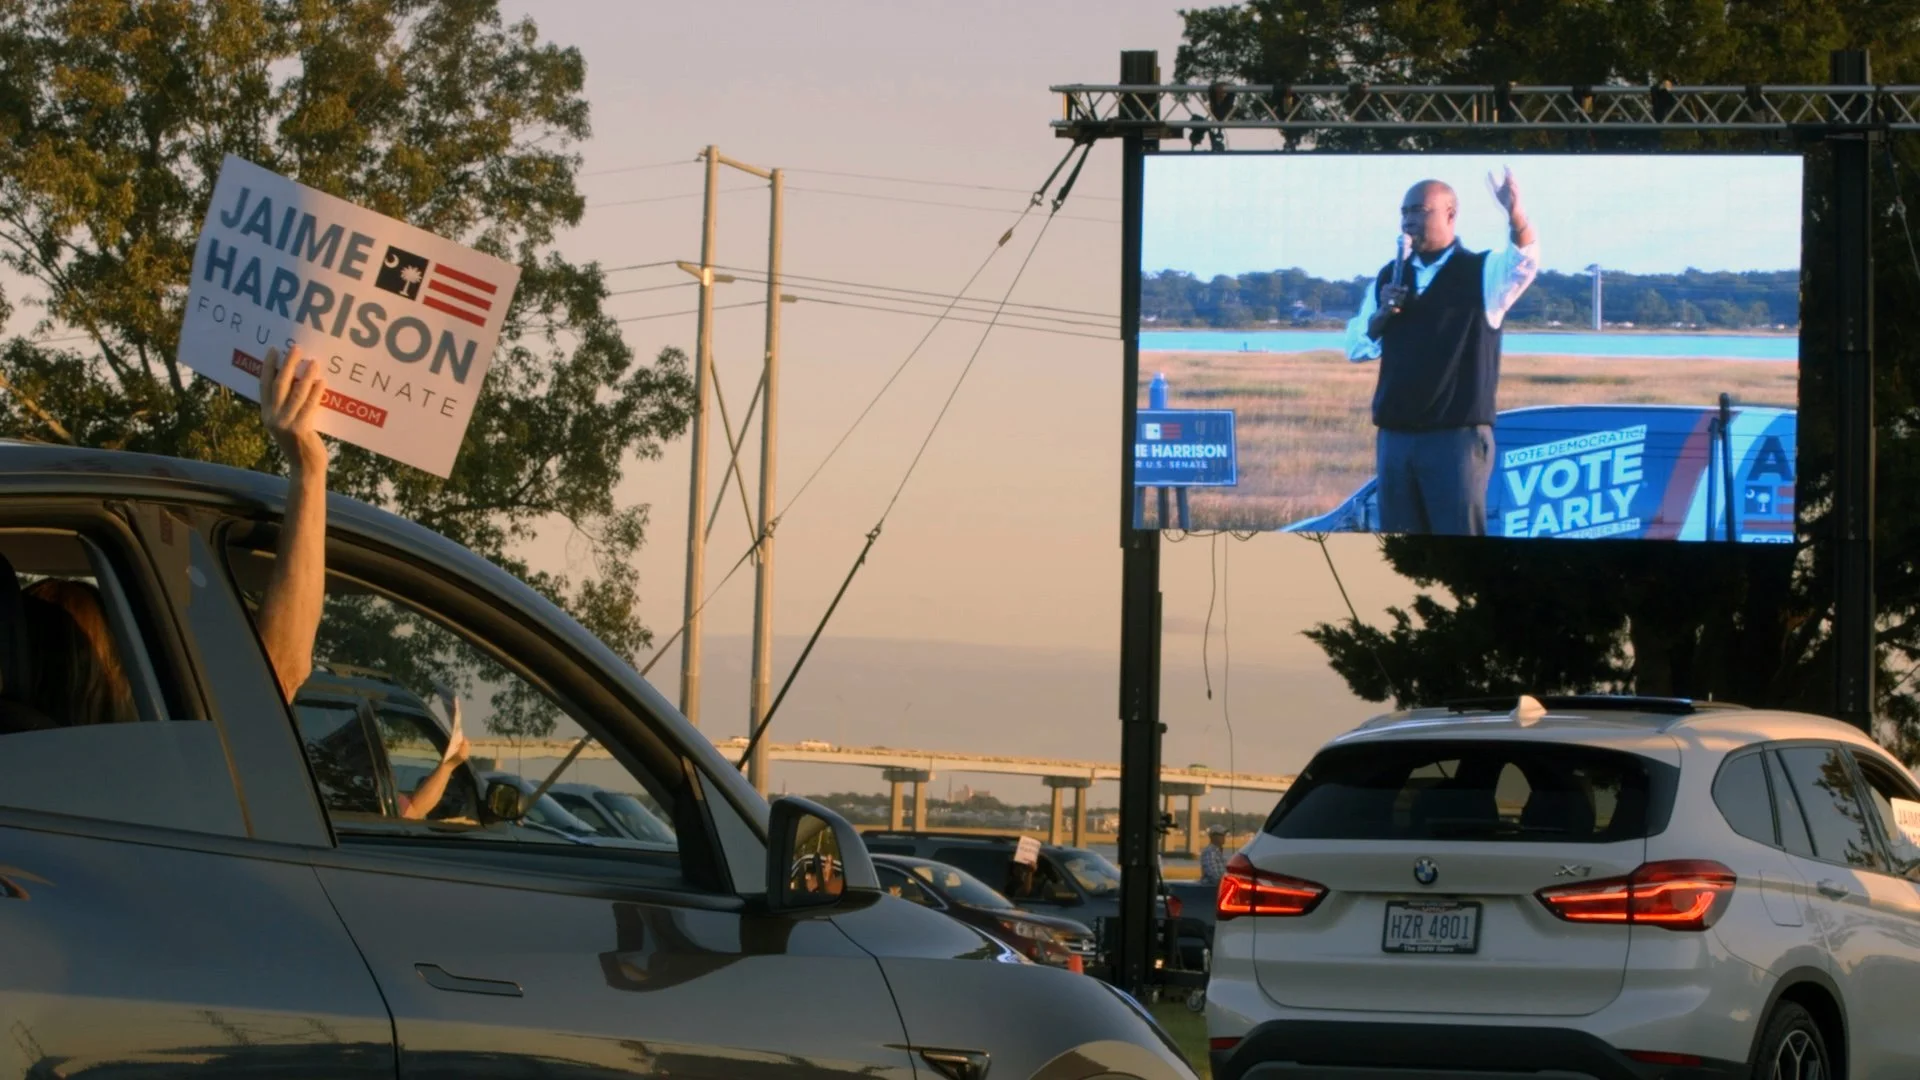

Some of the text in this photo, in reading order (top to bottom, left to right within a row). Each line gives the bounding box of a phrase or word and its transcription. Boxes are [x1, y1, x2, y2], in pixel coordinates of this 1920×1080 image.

[221, 187, 375, 281] JAIME
[204, 239, 478, 385] HARRISON
[198, 296, 242, 332] FOR
[328, 355, 458, 418] SENATE
[235, 353, 382, 424] JAIMON.COM
[1151, 444, 1228, 458] HARRISON
[1169, 460, 1209, 469] SENATE
[1505, 443, 1645, 506] VOTE
[1507, 447, 1544, 464] VOTE
[1747, 436, 1793, 480] A
[1504, 483, 1640, 537] EARLY
[1391, 914, 1470, 940] HZR 4801
